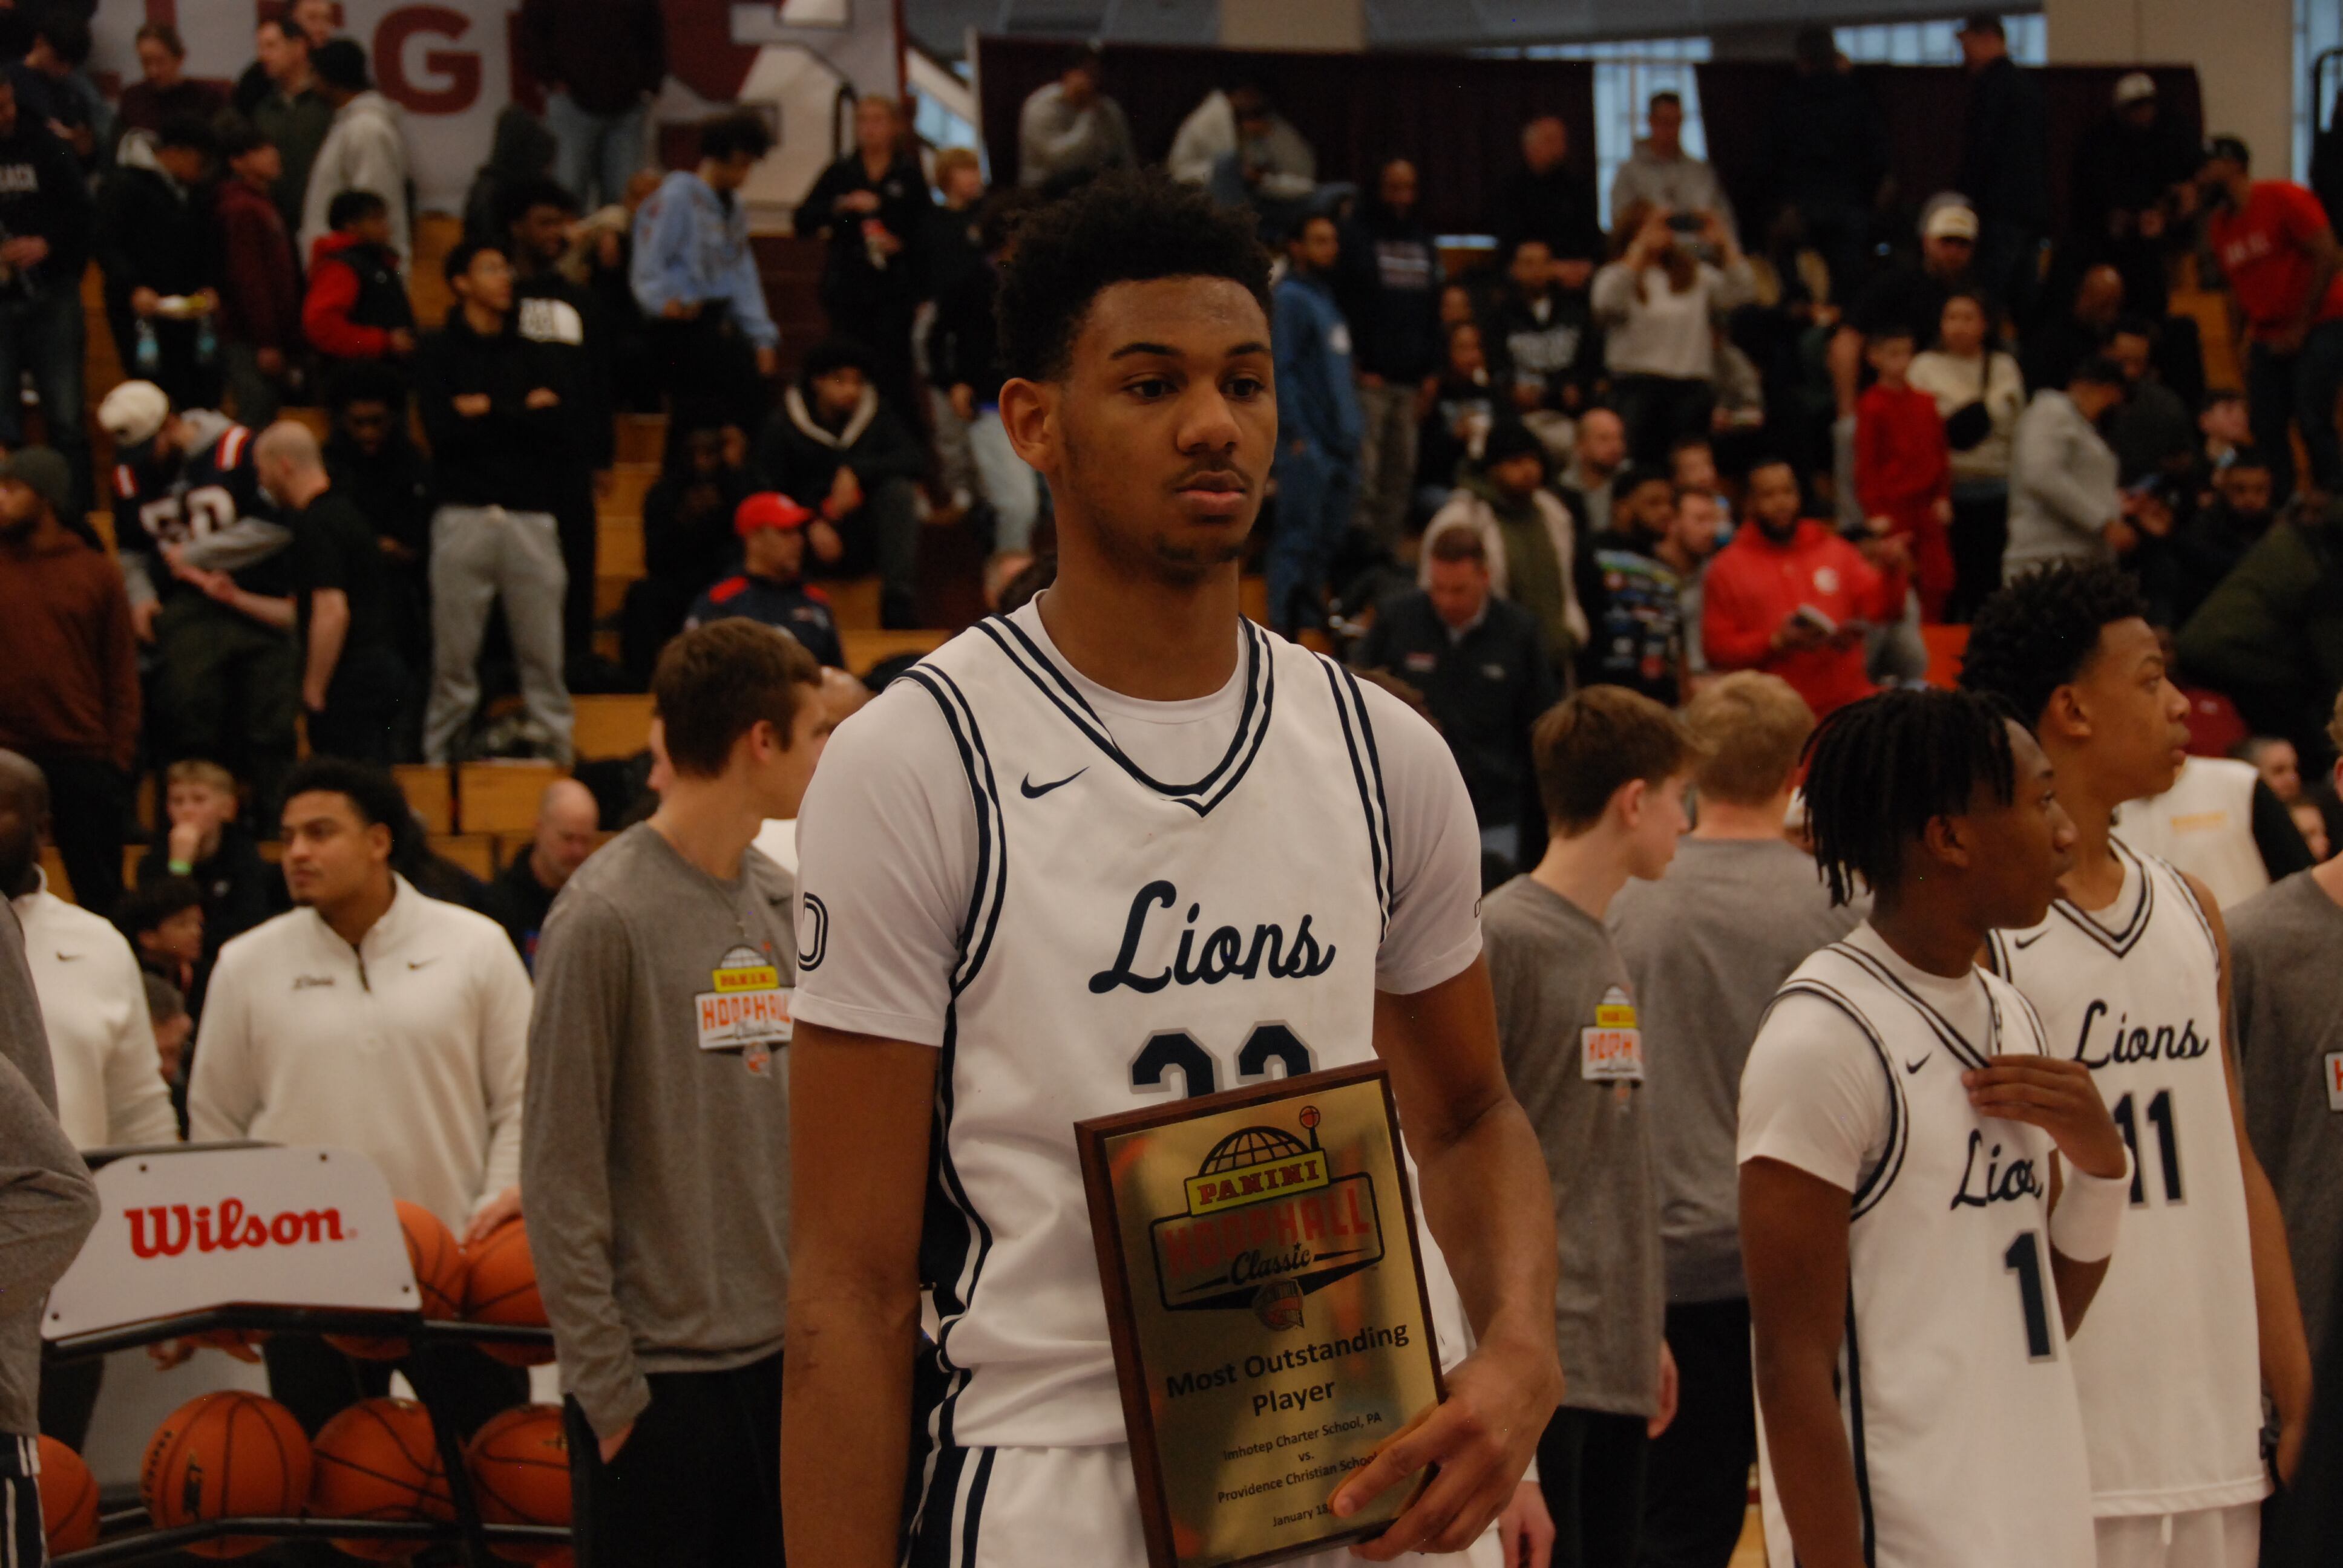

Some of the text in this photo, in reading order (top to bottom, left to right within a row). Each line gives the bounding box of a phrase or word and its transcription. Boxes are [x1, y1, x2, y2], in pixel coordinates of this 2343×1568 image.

[1089, 880, 1336, 994] Lions
[2073, 999, 2209, 1070] Lions
[2113, 1089, 2186, 1206] 11
[1197, 1159, 1320, 1206] PANINI
[125, 1198, 342, 1258] Wilson
[1163, 1188, 1370, 1278] HOOPHALL
[1231, 1242, 1312, 1286] Classic
[2004, 1230, 2056, 1364] 1
[1166, 1324, 1409, 1399] Most Outstanding
[1252, 1381, 1336, 1416] Player
[1224, 1412, 1382, 1462] Imhotep Charter School, PA
[1298, 1452, 1315, 1462] vs.
[1217, 1478, 1283, 1503] Providence
[1286, 1463, 1337, 1485] Christian
[1273, 1509, 1314, 1527] January
